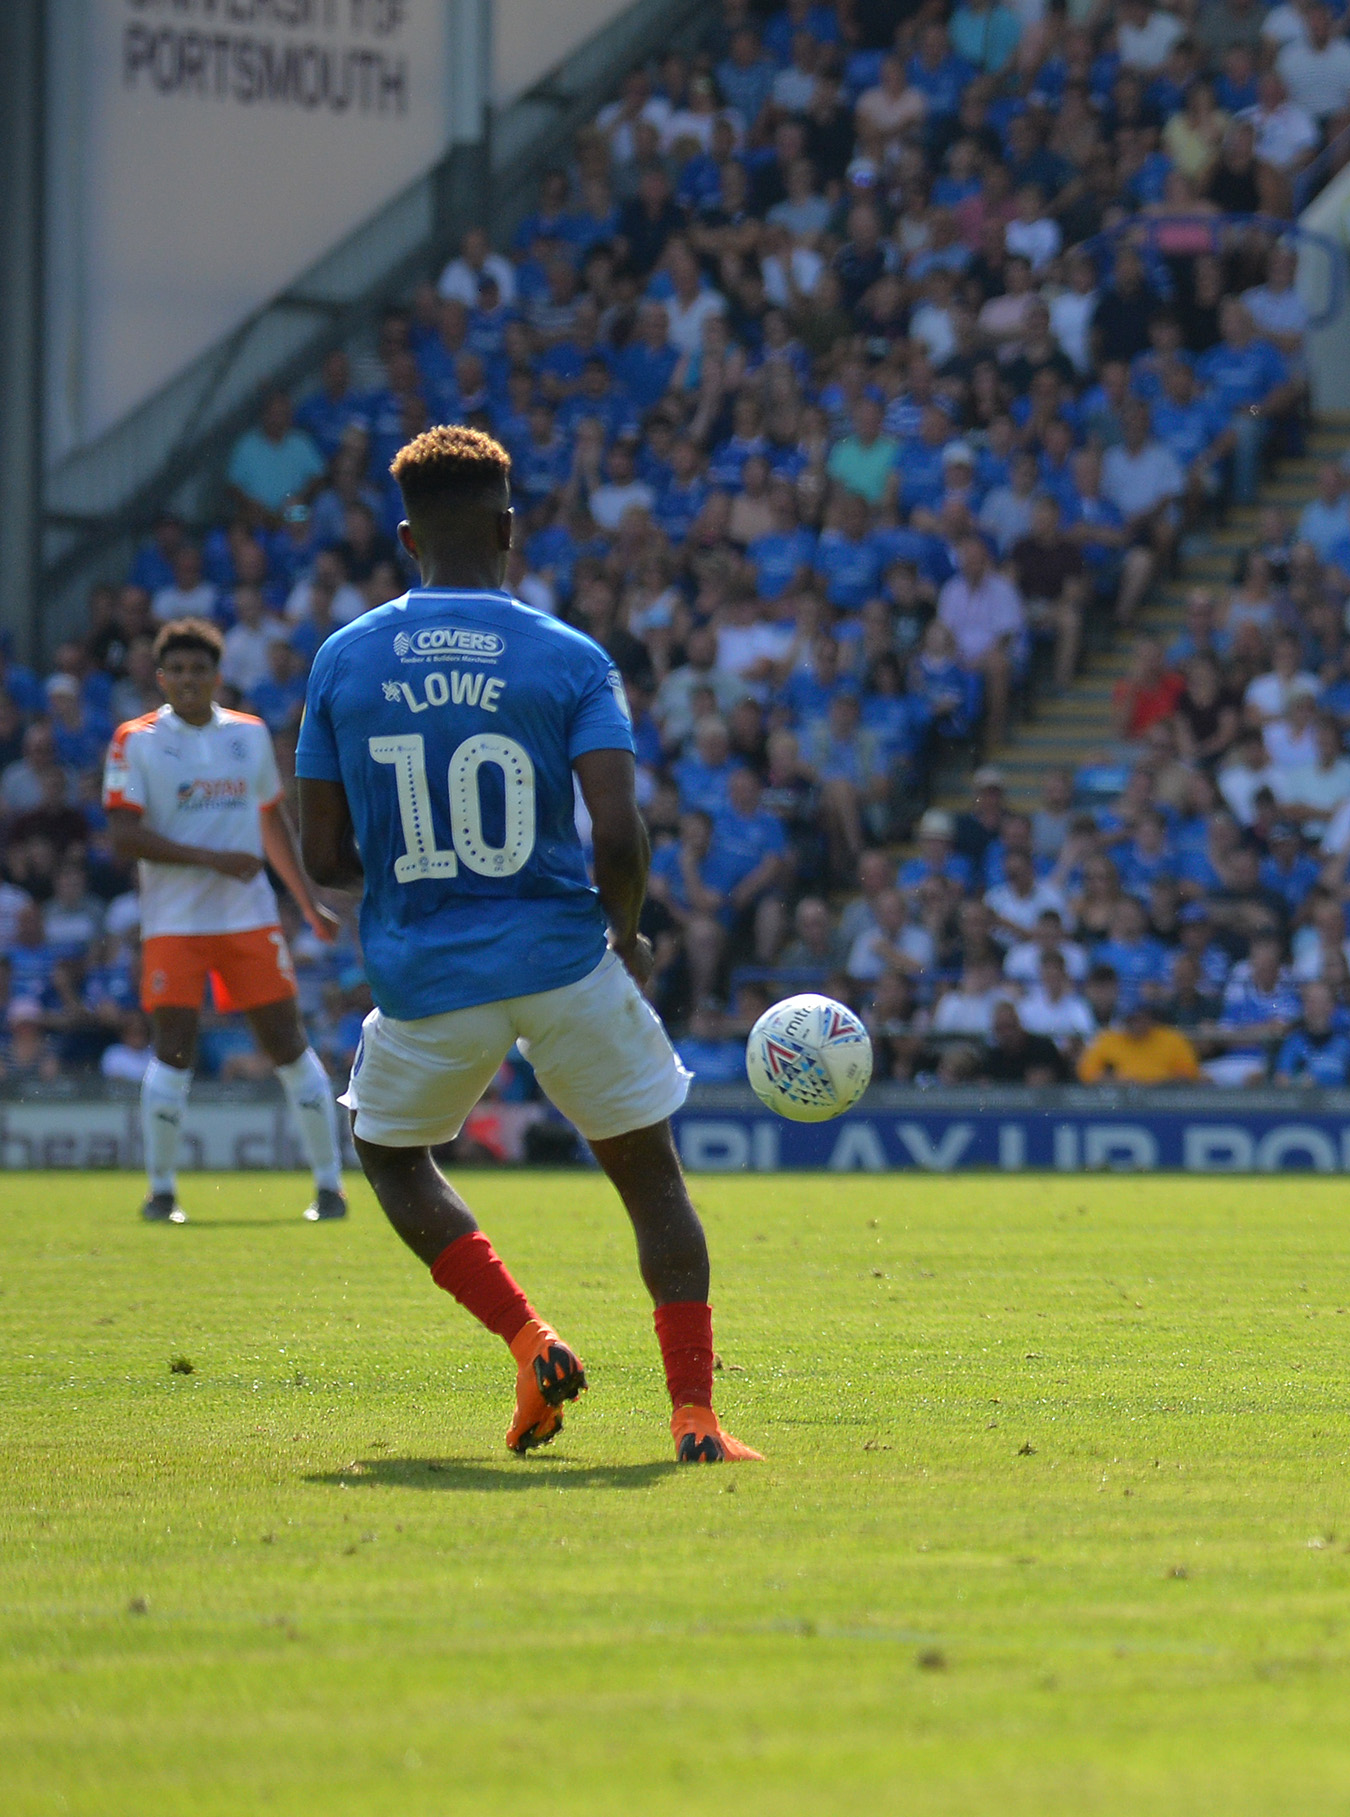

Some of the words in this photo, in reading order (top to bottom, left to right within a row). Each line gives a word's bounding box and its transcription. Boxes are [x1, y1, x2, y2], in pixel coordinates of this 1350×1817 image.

[124, 21, 409, 118] PORTSMOUTH
[417, 630, 498, 650] COVERS
[402, 670, 506, 713] LOWE
[368, 733, 535, 884] 10
[785, 1005, 812, 1037] mitr
[680, 1121, 975, 1171] PLAY
[1001, 1122, 1158, 1172] UP
